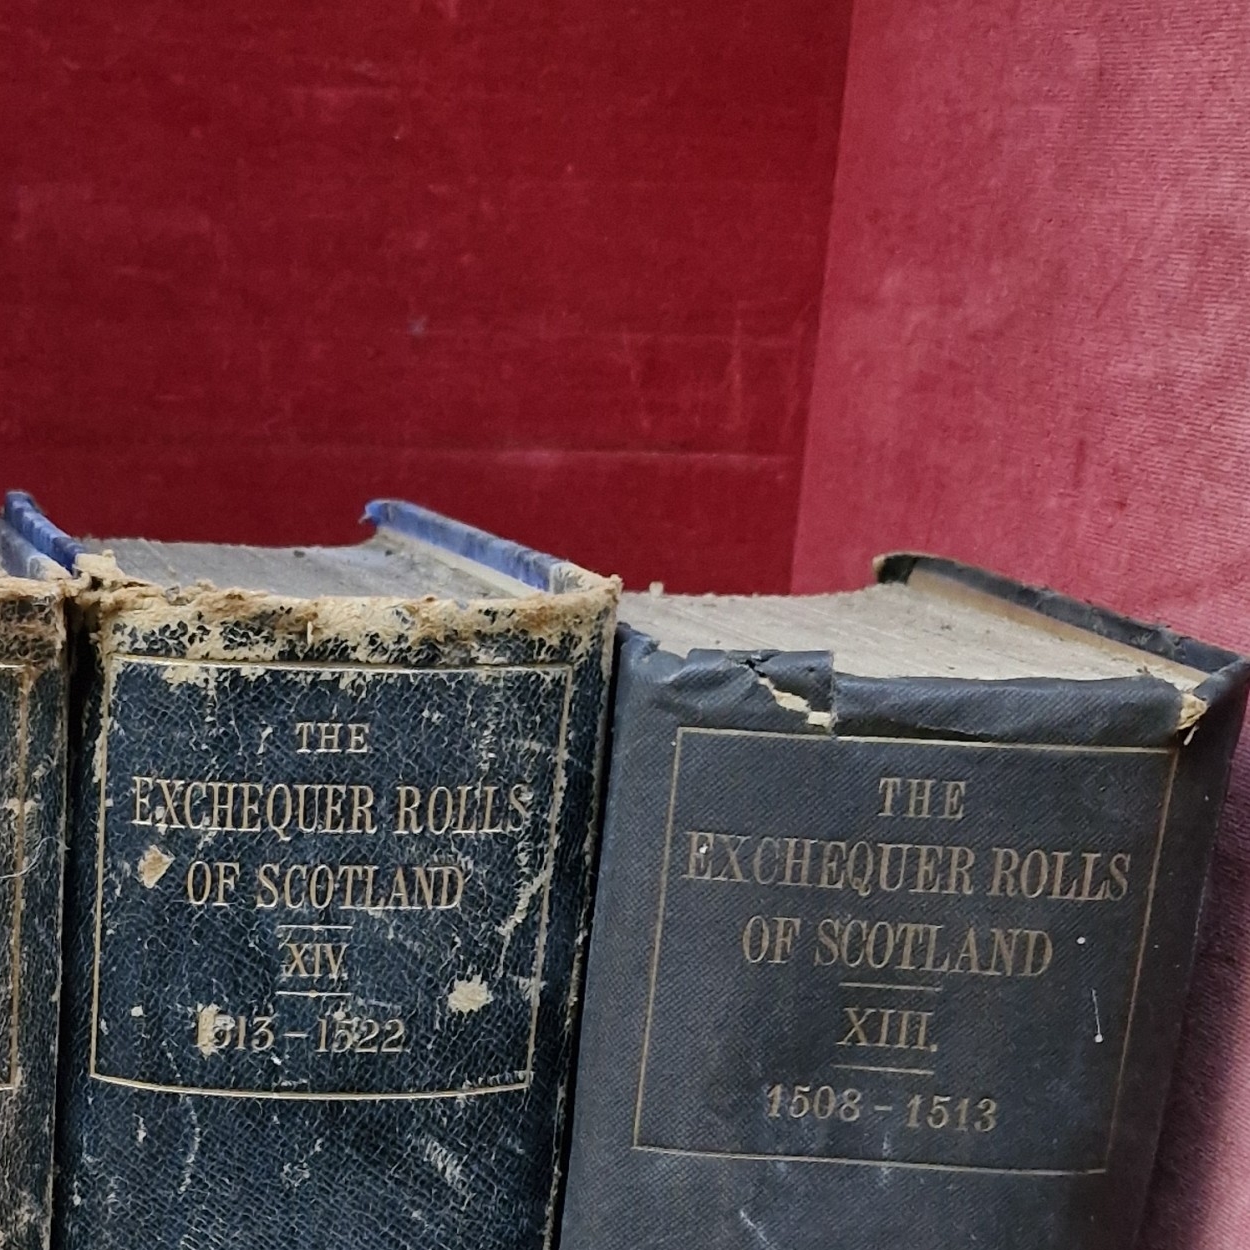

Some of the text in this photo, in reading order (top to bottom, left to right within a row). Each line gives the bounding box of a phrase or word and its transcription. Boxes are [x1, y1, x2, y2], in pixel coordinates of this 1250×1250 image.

[295, 721, 371, 754] THE
[131, 776, 535, 842] EXCHEQUER ROLLS
[877, 776, 967, 820] THE
[186, 860, 466, 911] OF SCOTLAND
[681, 830, 1132, 901] EXCHEQUER ROLLS
[283, 943, 350, 978] XIV
[741, 915, 1053, 978] OF SCOTLAND
